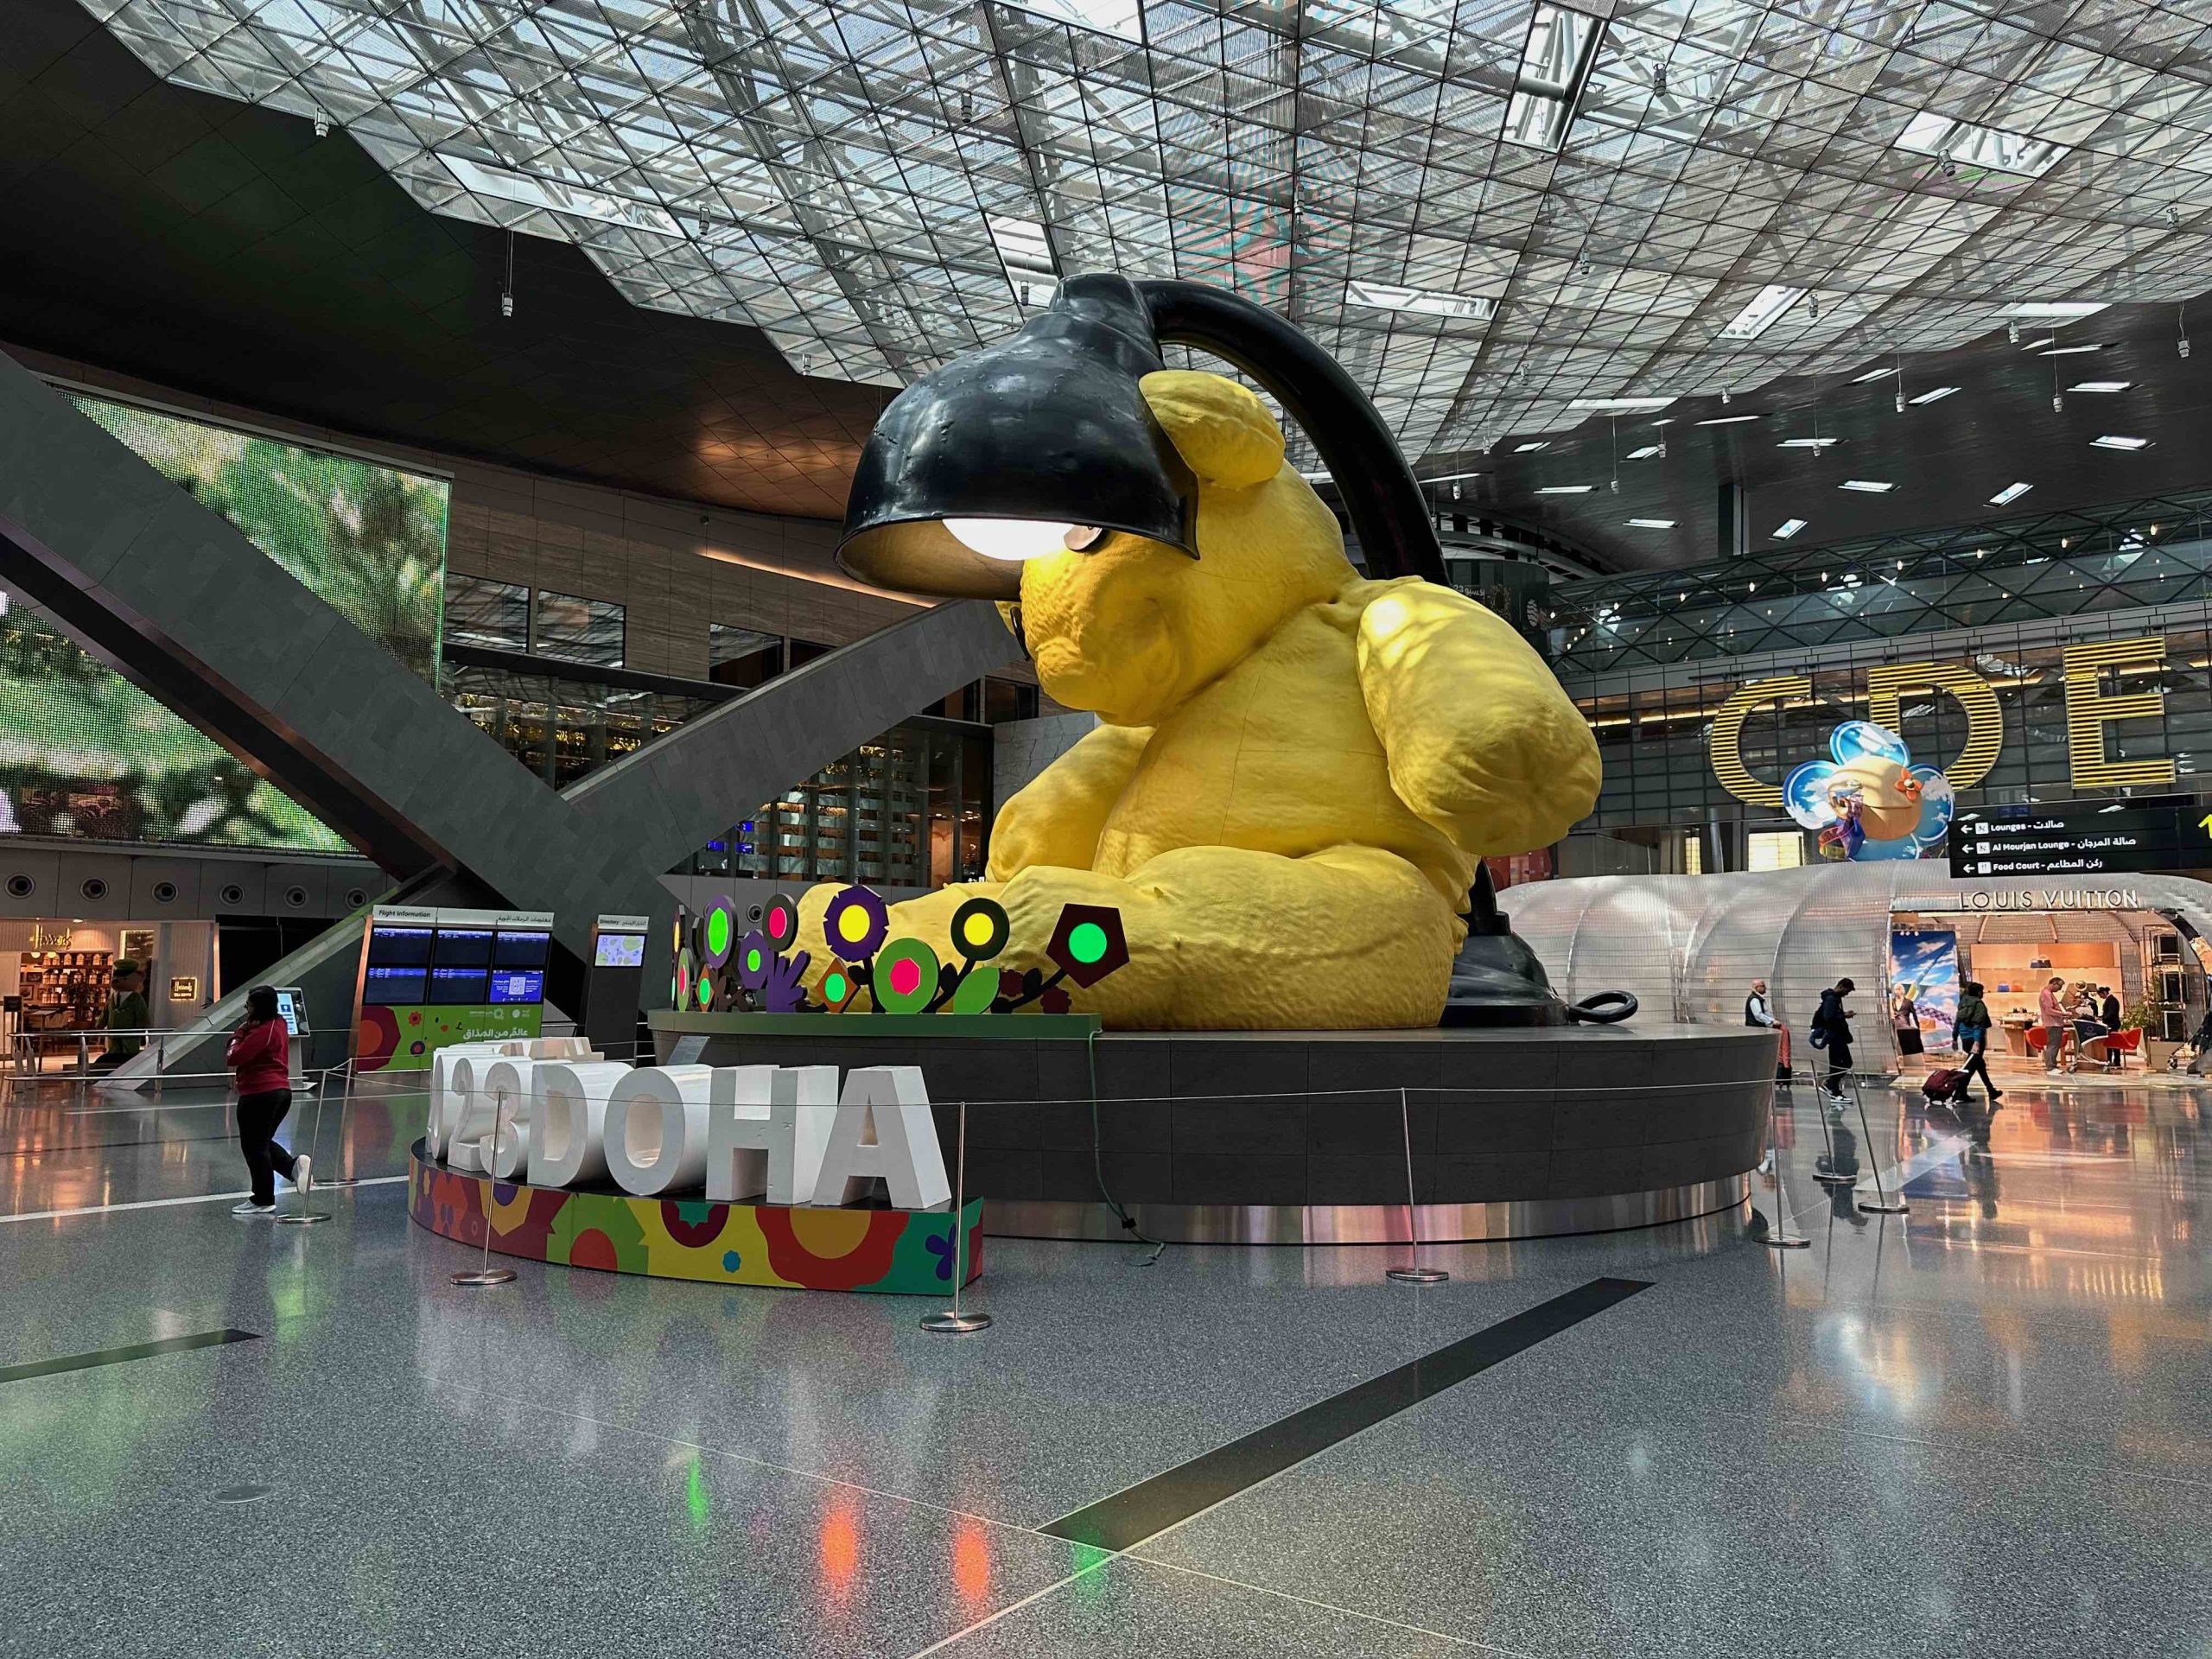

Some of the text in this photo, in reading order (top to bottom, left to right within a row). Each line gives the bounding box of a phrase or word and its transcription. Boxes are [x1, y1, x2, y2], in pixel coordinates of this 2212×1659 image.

[1710, 636, 2176, 807] C D E
[1991, 823, 2026, 832] Lounges
[2033, 820, 2064, 830] صالات
[2037, 841, 2069, 851] Lounge
[2077, 837, 2111, 849] المرجان
[2113, 836, 2137, 846] صالة
[2003, 842, 2037, 853] Mourjan
[1993, 862, 2014, 871] Food
[2015, 862, 2040, 871] Court
[2047, 859, 2084, 871] المطاعم
[2085, 859, 2103, 868] ركن
[1958, 889, 2139, 909] LOUIS VUITTON
[29, 925, 73, 950] Harrods
[527, 1061, 952, 1209] DOHA
